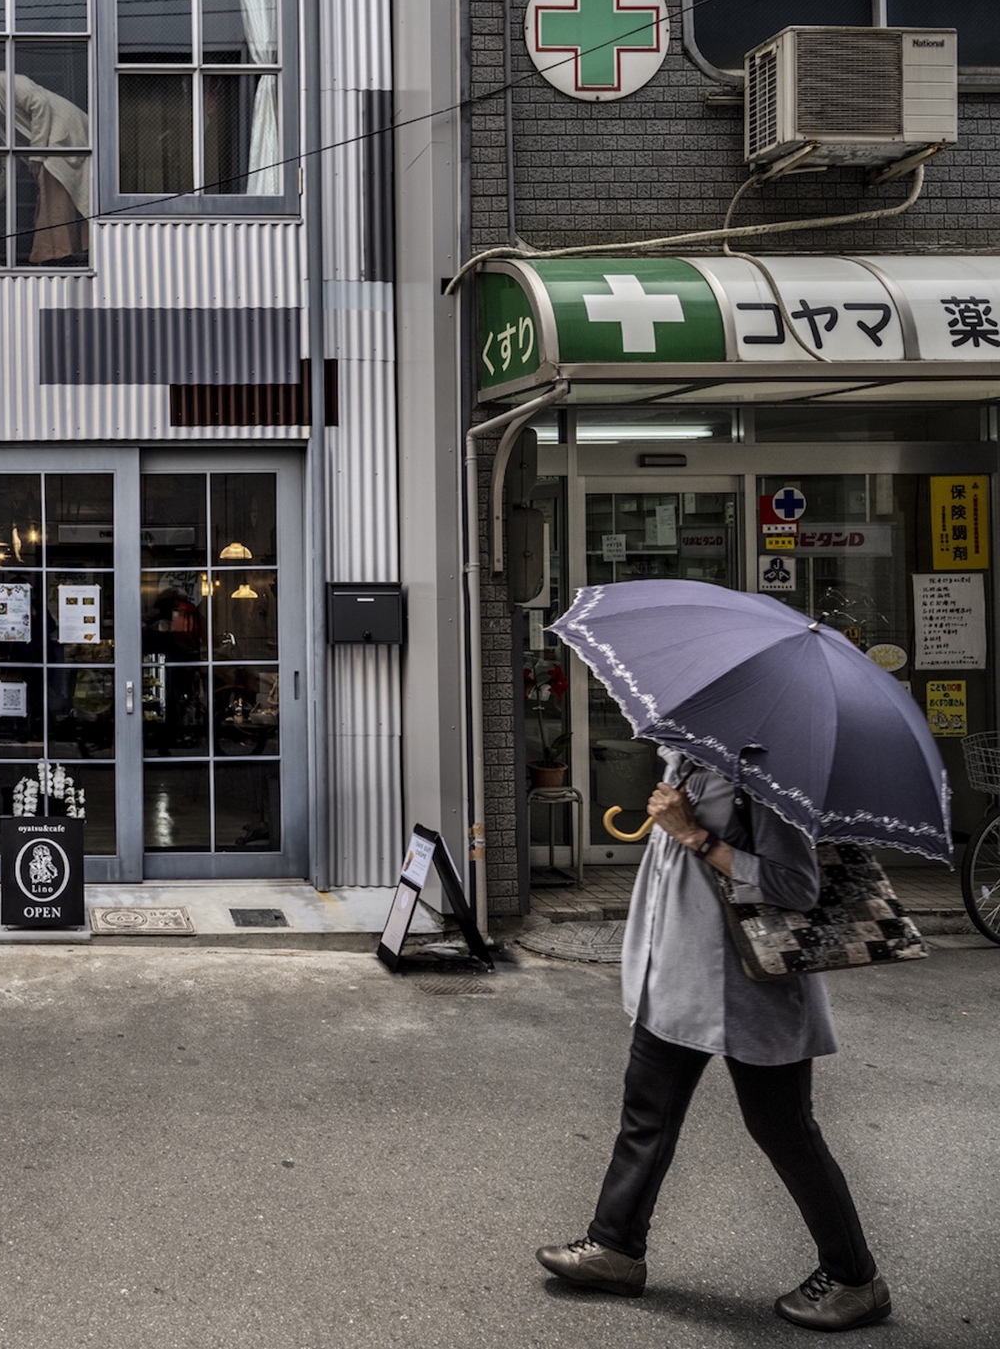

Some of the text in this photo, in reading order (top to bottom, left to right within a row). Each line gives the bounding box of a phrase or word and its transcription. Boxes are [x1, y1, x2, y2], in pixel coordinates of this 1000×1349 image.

[912, 39, 945, 48] National
[736, 296, 1000, 349] コヤマ 薬
[482, 316, 534, 376] くすり
[951, 484, 968, 561] 保険調剤
[18, 825, 66, 834] oyatsu&cafe
[31, 885, 53, 893] Lino
[23, 907, 62, 918] OPEN
